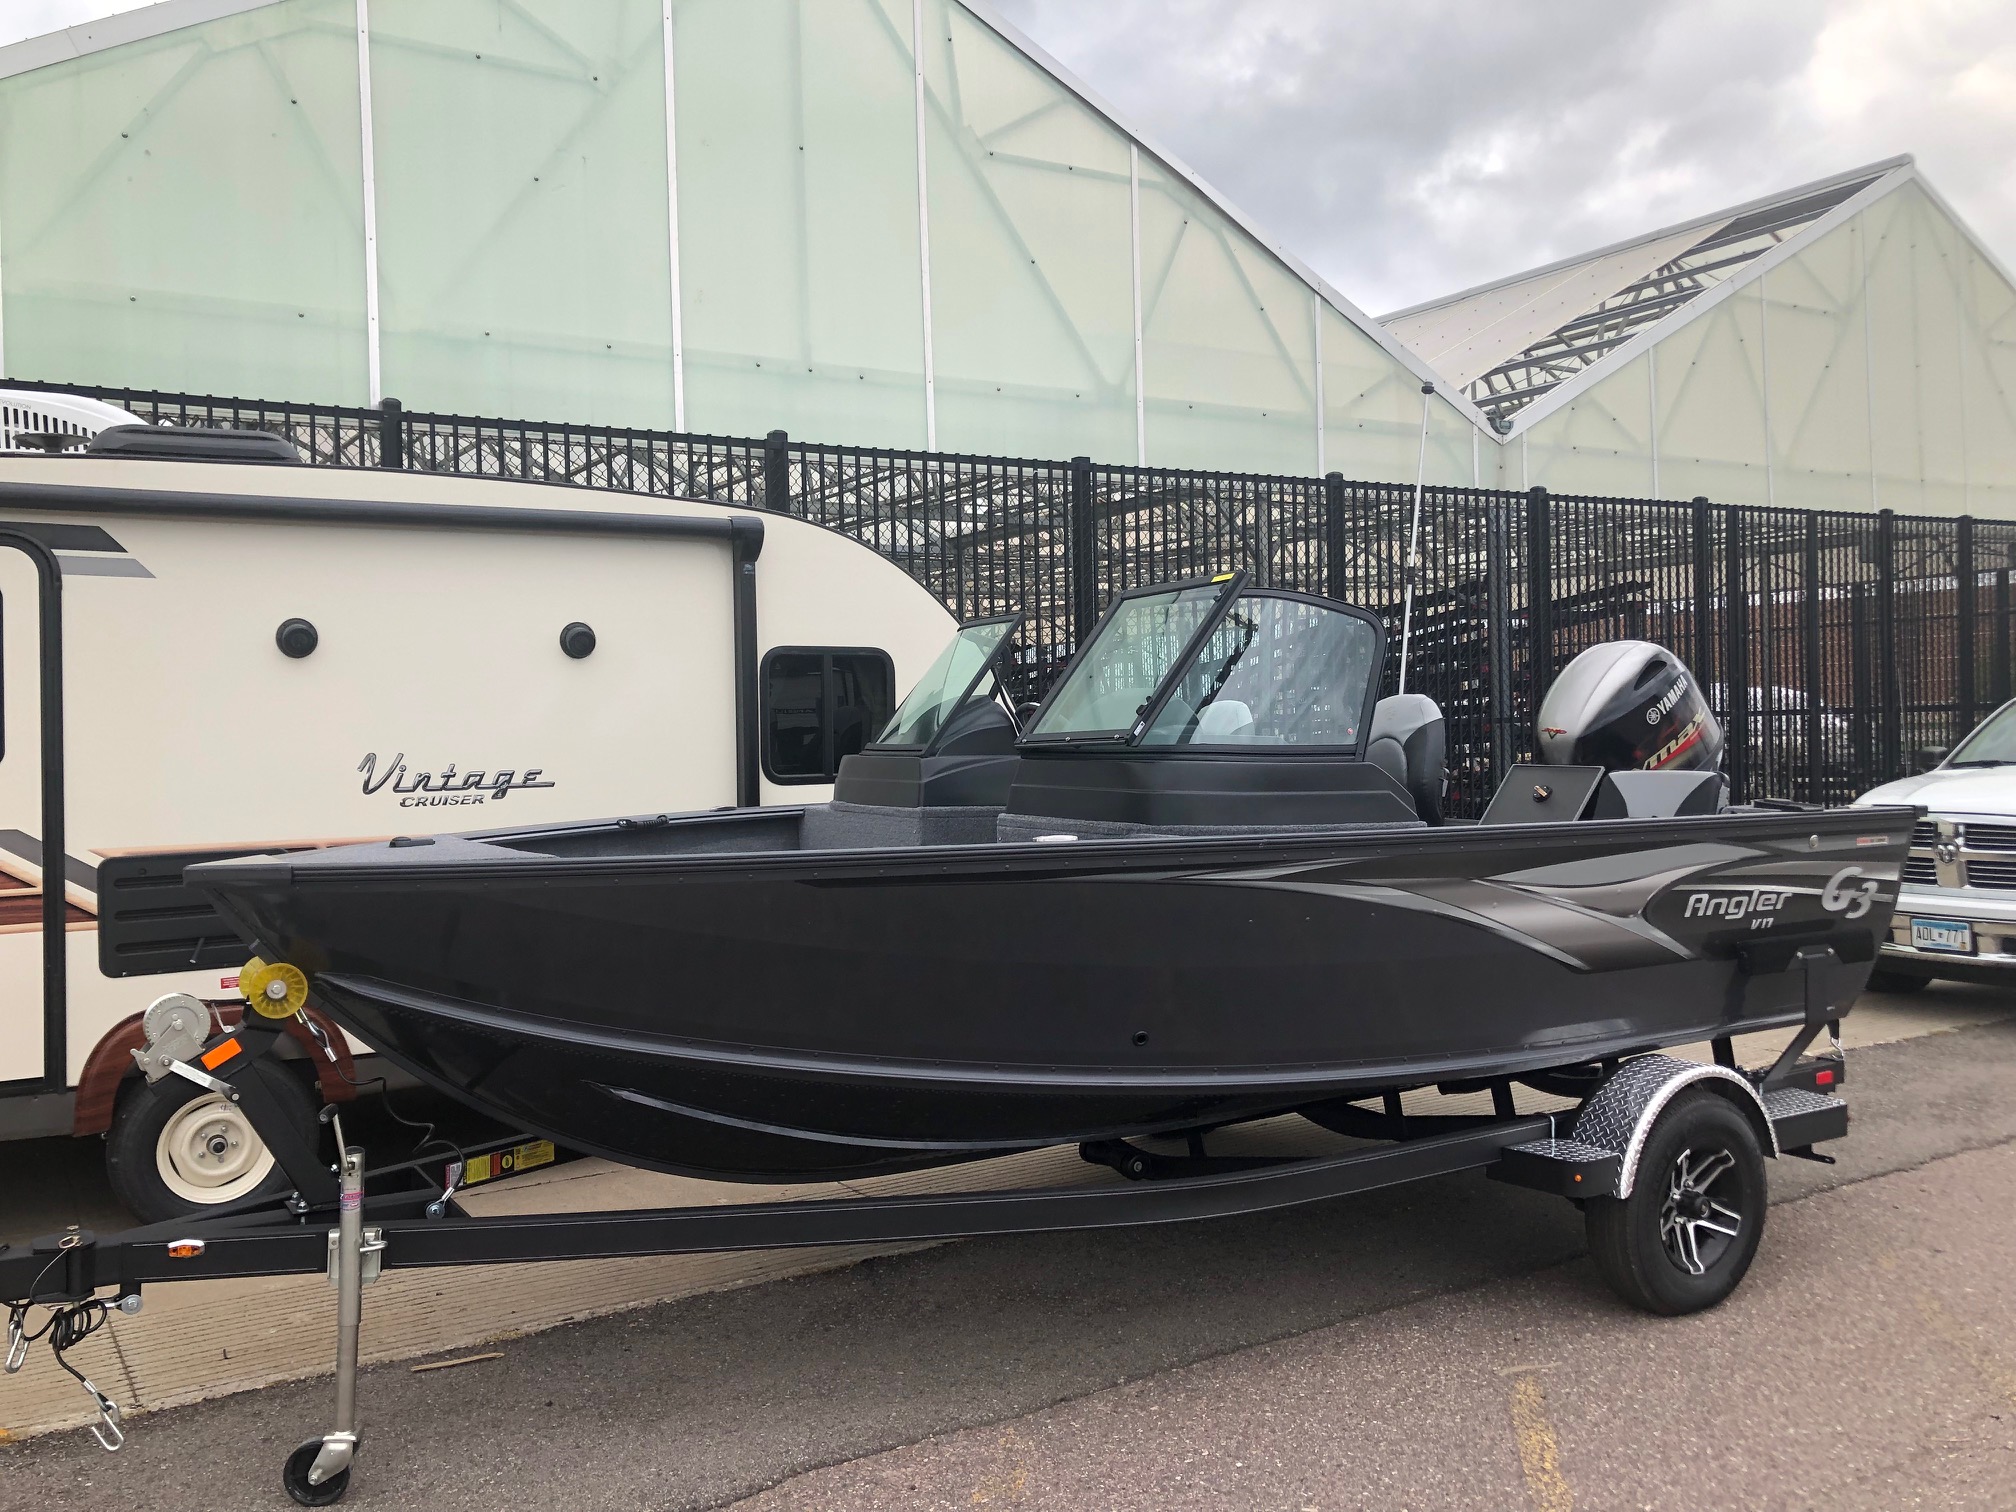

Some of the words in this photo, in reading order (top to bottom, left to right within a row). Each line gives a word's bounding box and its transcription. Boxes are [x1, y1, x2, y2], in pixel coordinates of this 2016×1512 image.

[0, 399, 31, 410] VOLUTION
[1656, 674, 1688, 715] YAMAHA
[357, 752, 555, 800] Vintage
[399, 794, 484, 808] CRUISER
[1684, 889, 1793, 920] Angler
[1821, 866, 1879, 919] G3
[1751, 917, 1774, 930] V17
